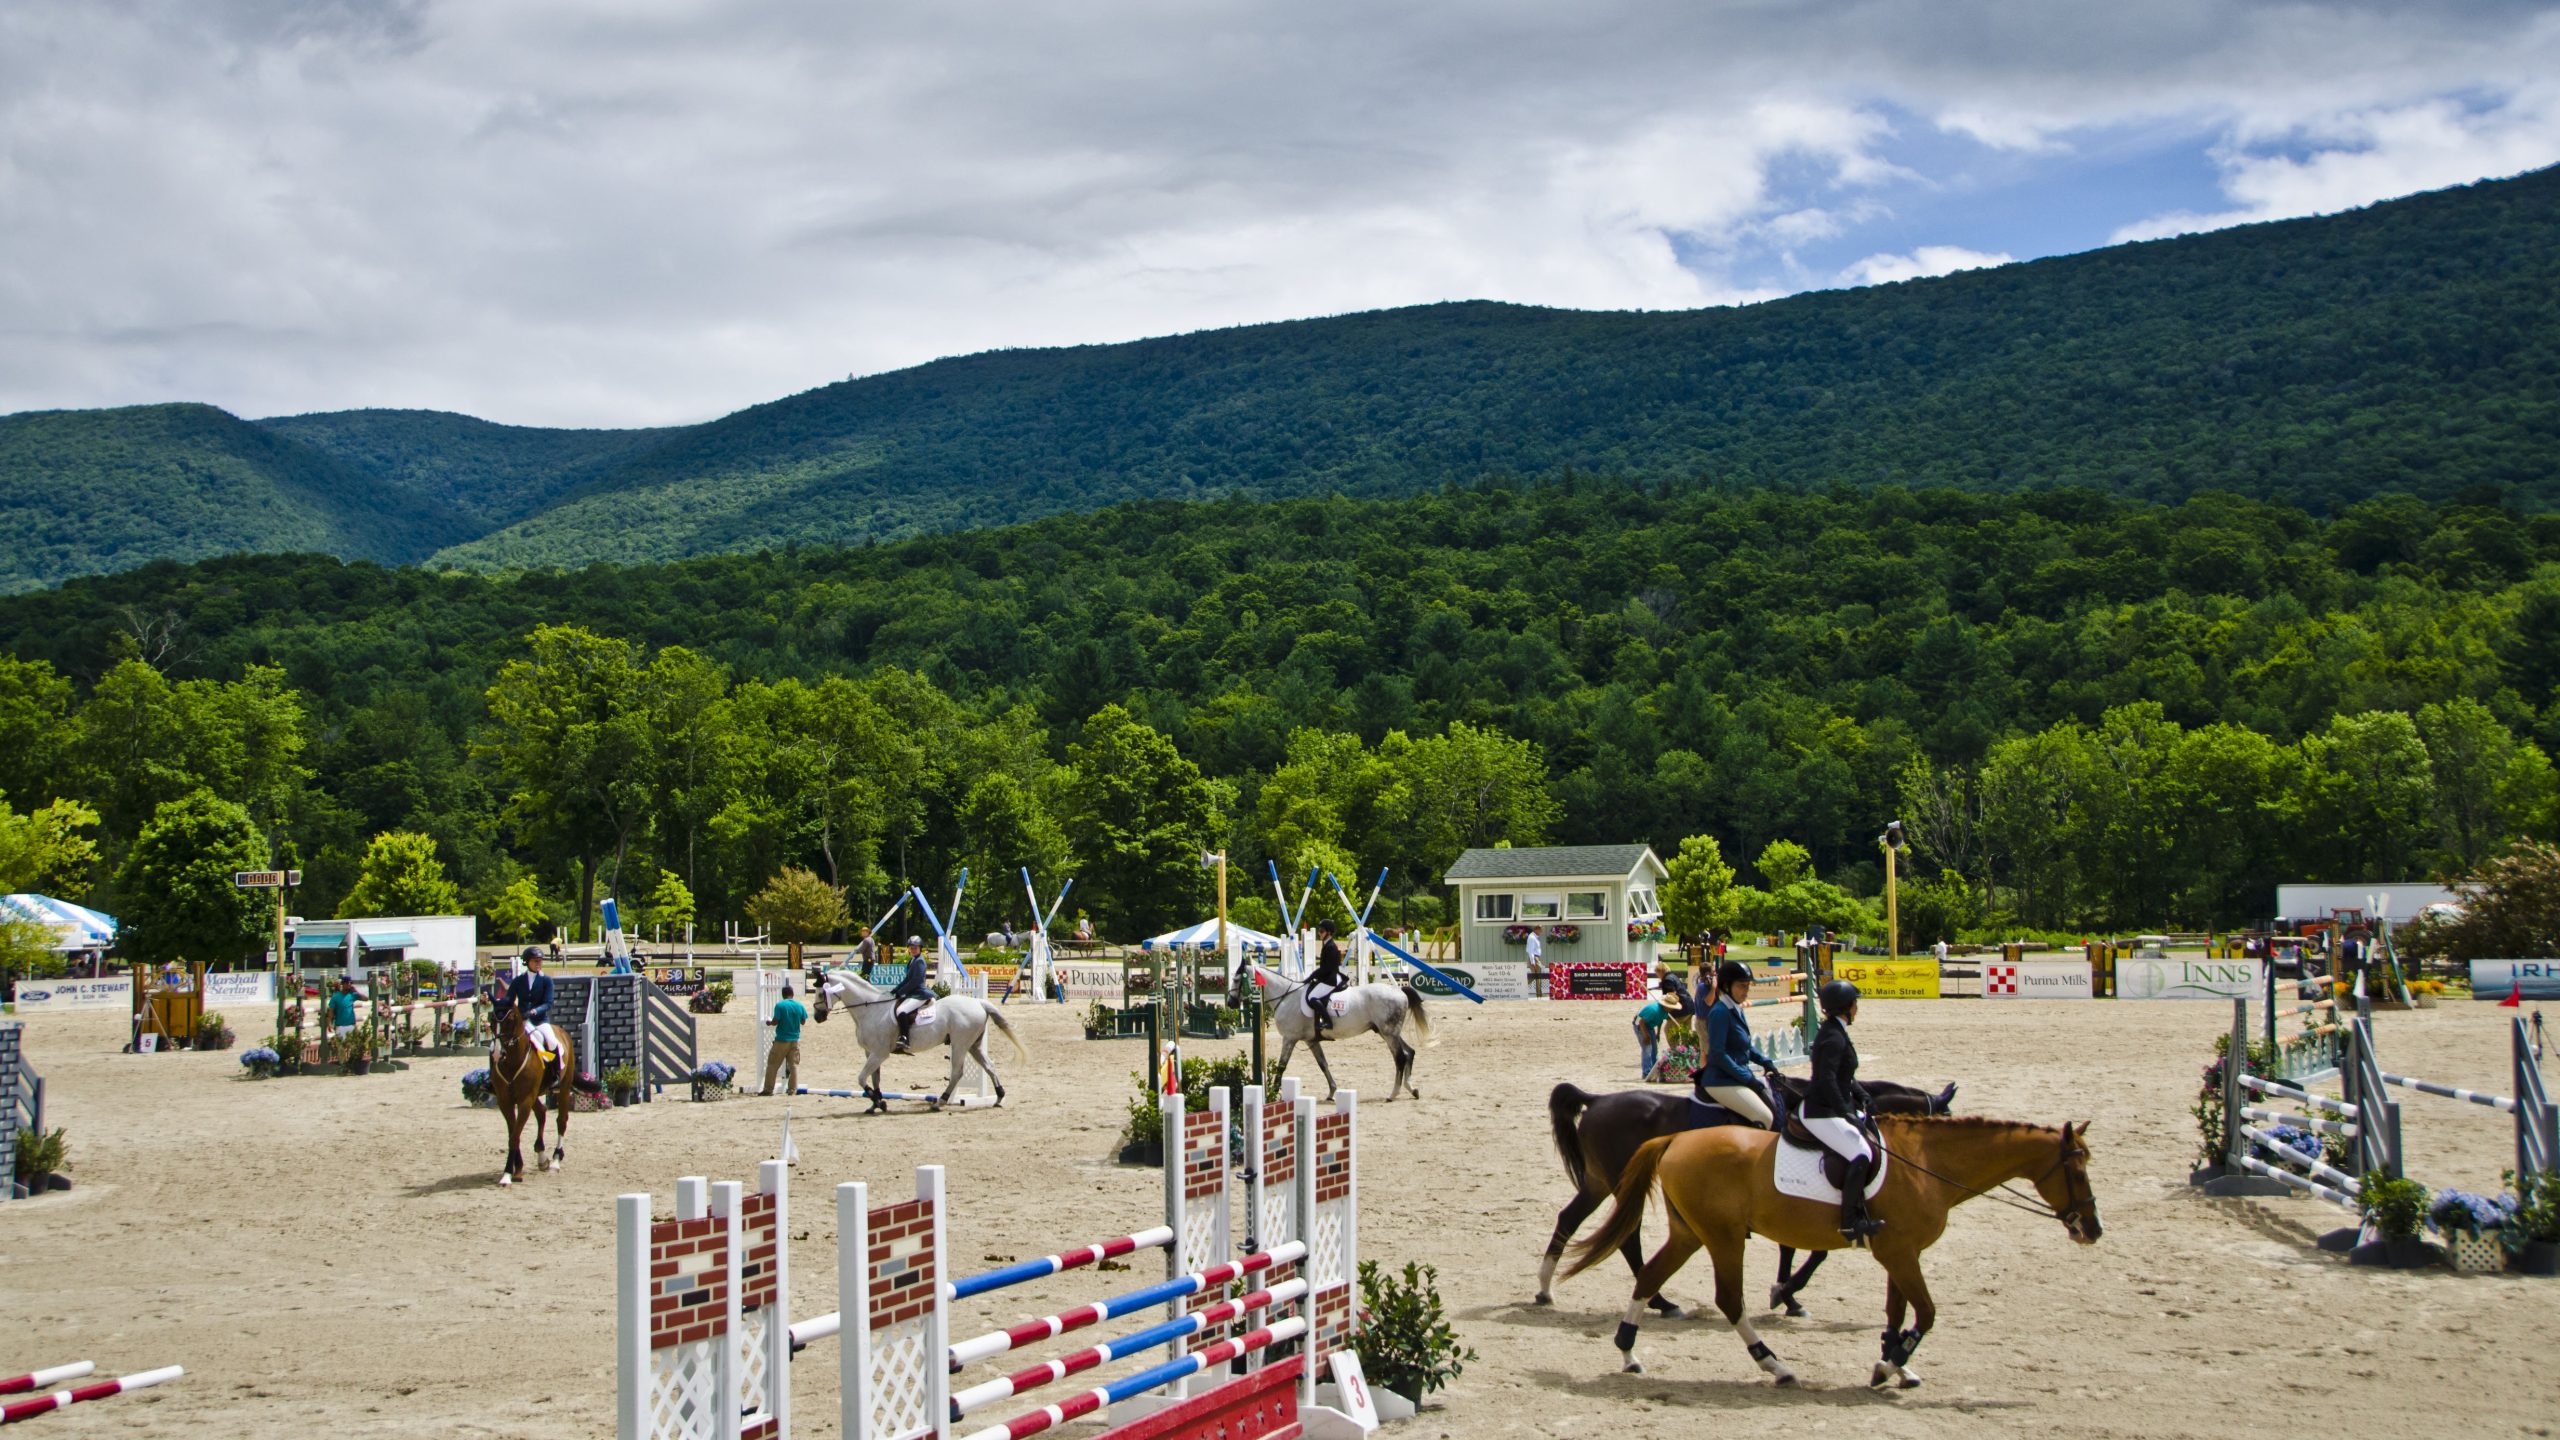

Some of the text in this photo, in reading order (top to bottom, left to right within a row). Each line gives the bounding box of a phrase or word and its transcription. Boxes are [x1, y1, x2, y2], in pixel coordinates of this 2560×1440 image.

[1838, 968, 1867, 982] UGG
[2181, 960, 2252, 983] INNS
[205, 972, 259, 985] Marshall
[2024, 974, 2088, 986] Purina Mills
[55, 983, 130, 994] JOHN C. STEWART
[211, 984, 258, 996] Sterling
[145, 1038, 151, 1048] 5
[1350, 1374, 1365, 1409] 3
